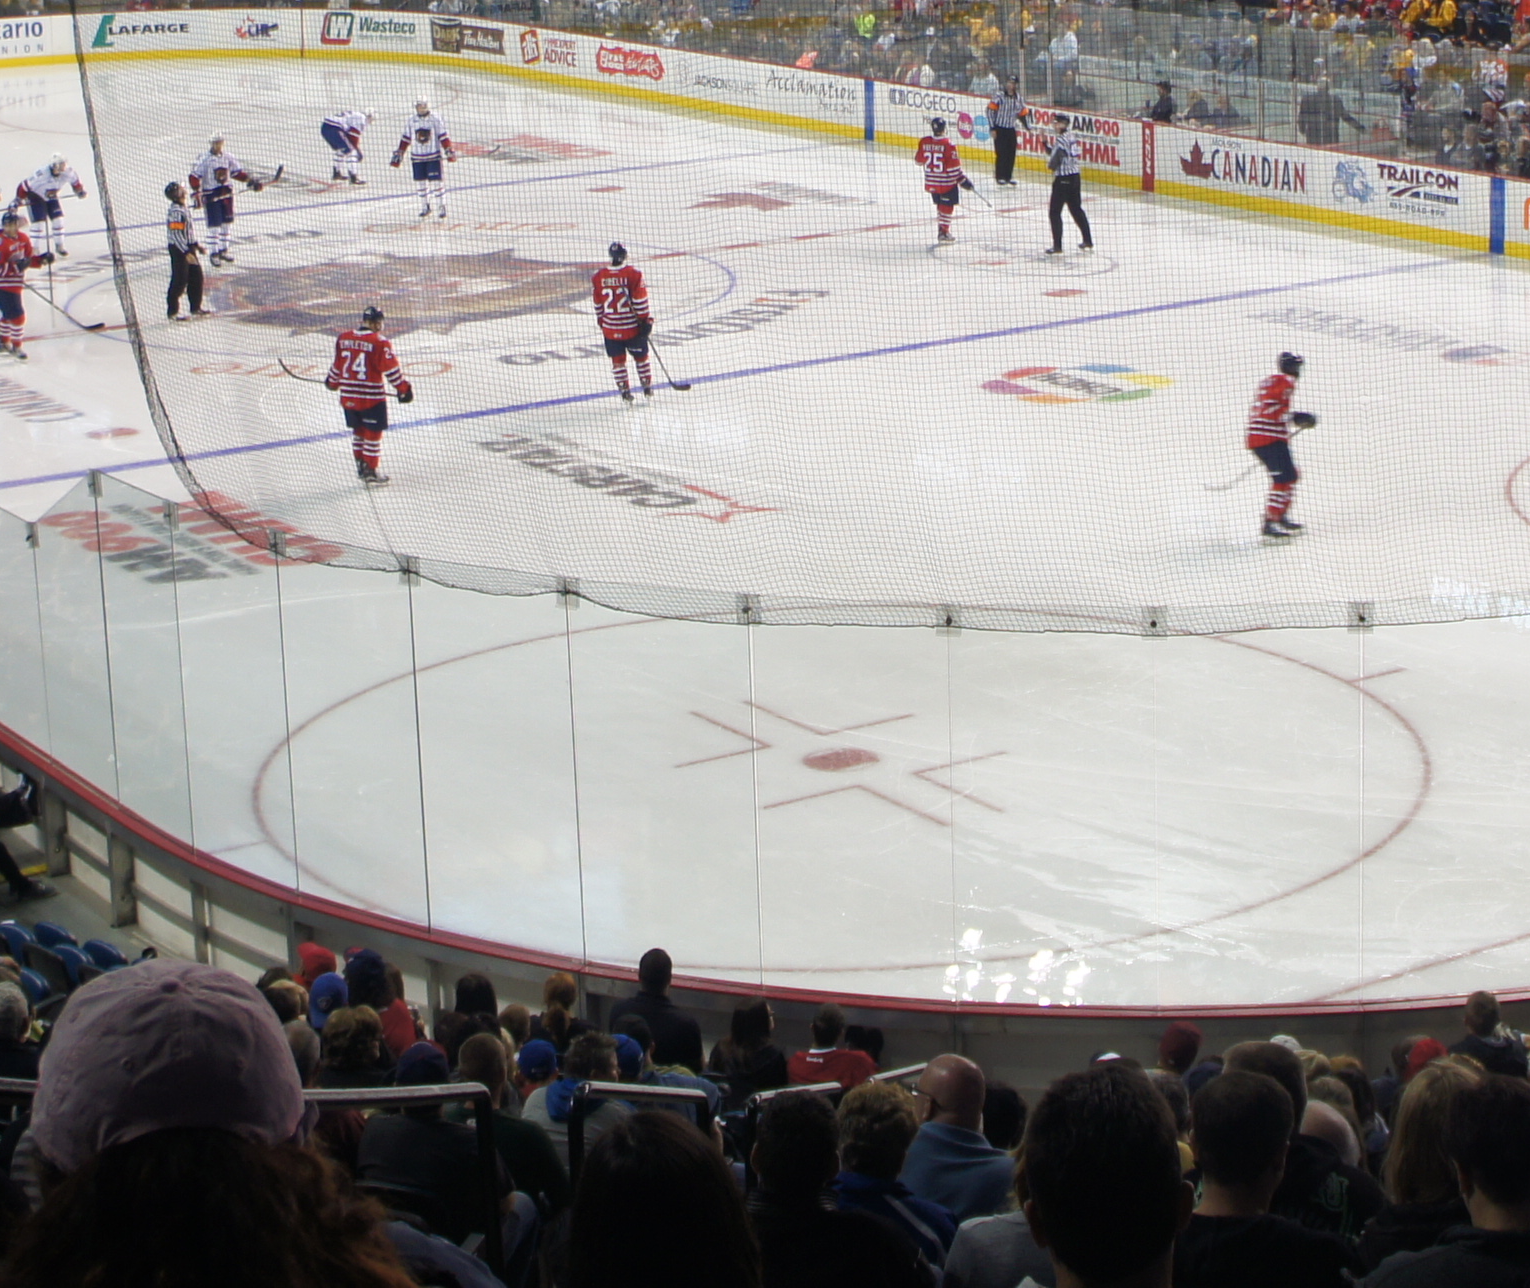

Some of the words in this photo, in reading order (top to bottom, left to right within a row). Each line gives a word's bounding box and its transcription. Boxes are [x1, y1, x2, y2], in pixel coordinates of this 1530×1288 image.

[107, 22, 191, 36] LAFARGE
[359, 16, 416, 35] Wasteco
[544, 50, 577, 67] ADVICE
[768, 69, 857, 101] Acclamation
[906, 91, 957, 113] COGECO
[1072, 114, 1120, 137] AM900
[923, 152, 944, 172] 25
[1211, 148, 1307, 194] CANADIAN
[1377, 162, 1459, 190] TRAILCON
[601, 287, 630, 313] 22
[341, 351, 367, 380] 24
